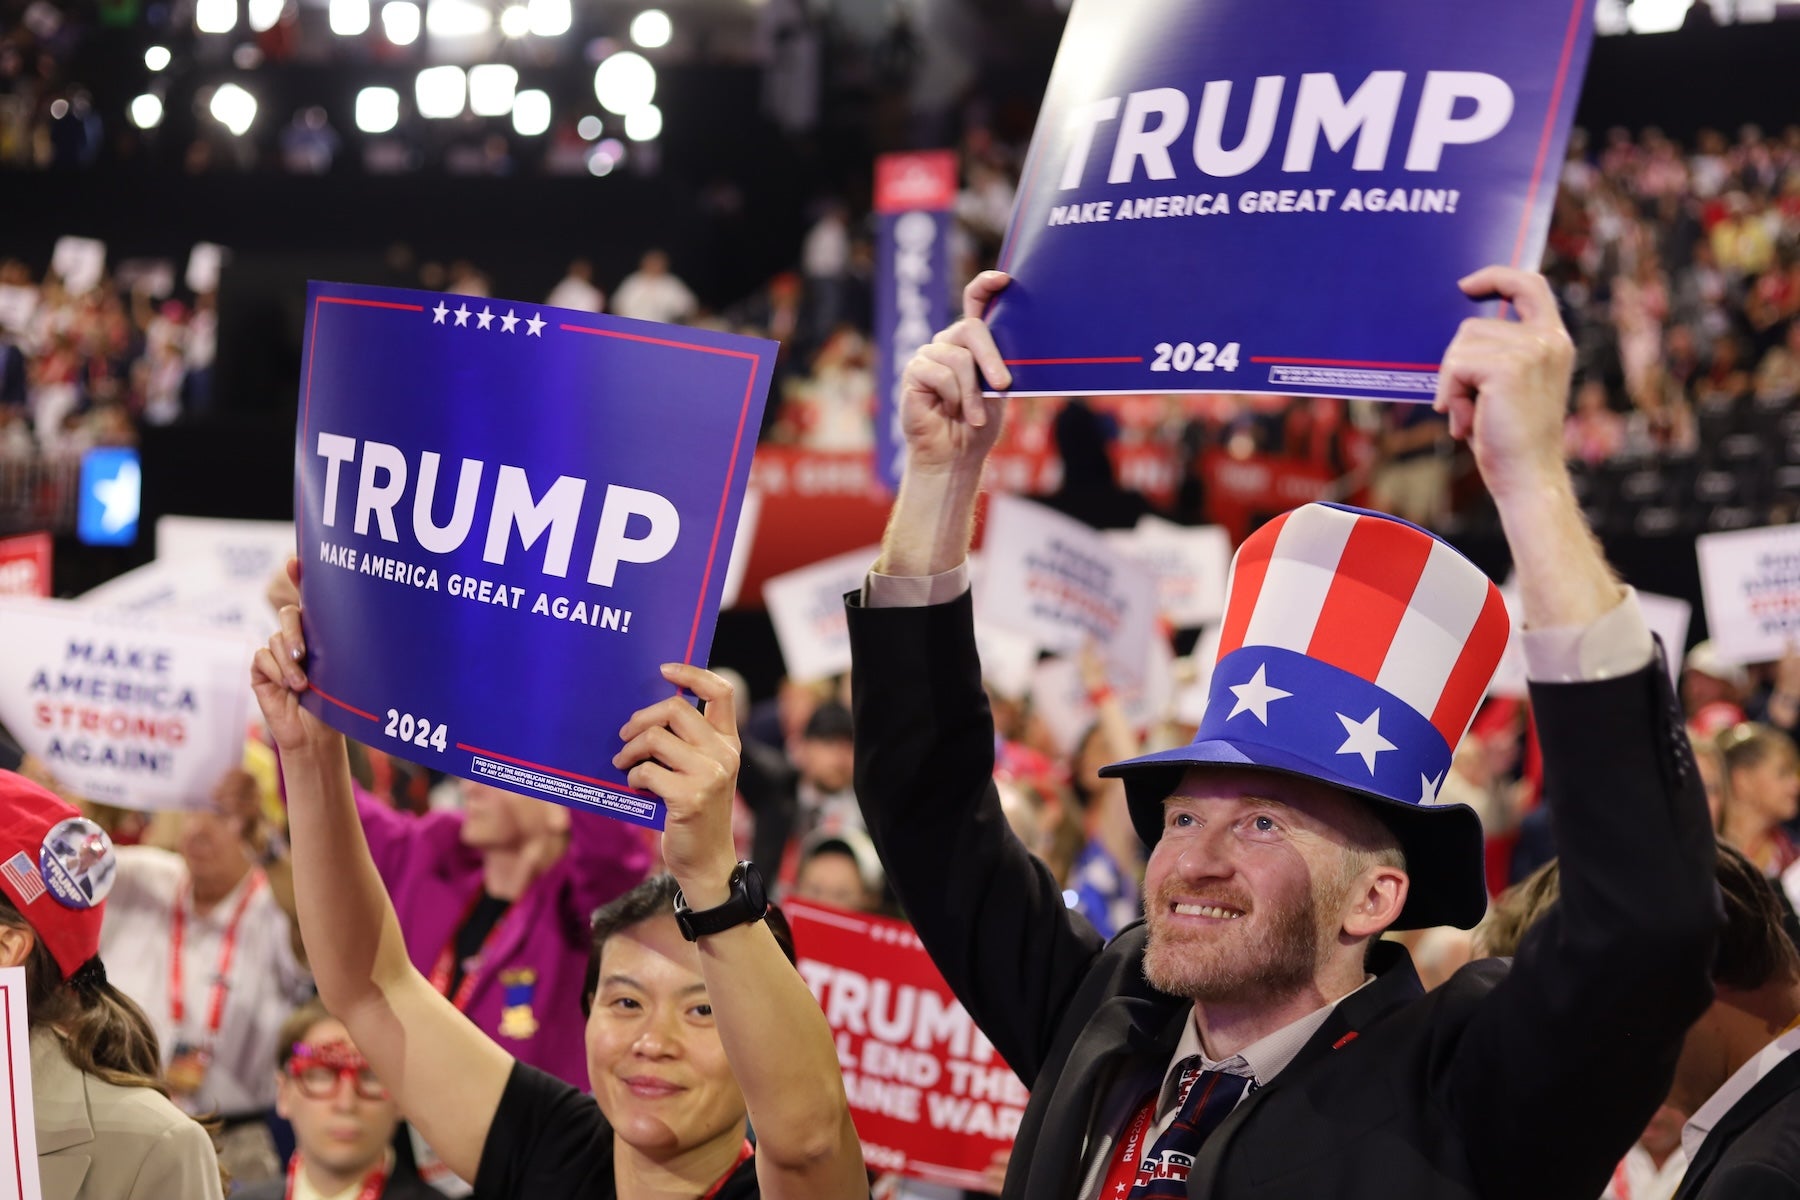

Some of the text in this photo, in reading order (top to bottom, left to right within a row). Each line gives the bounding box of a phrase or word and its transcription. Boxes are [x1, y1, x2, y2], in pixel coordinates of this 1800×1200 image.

[1059, 70, 1515, 191] TRUMP
[1047, 187, 1461, 227] MAKE AMERICA GREAT AGAIN!
[1149, 341, 1241, 372] 2024
[317, 431, 681, 588] TRUMP
[320, 541, 633, 634] MAKE AMERICA GREAT AGAIN!
[66, 638, 171, 672] MAKE
[30, 671, 197, 712] AMERICA
[35, 702, 188, 748] STRONG
[384, 708, 448, 753] 2024
[475, 759, 487, 768] PAID
[487, 762, 497, 770] FOR
[504, 767, 514, 775] THE
[514, 769, 546, 784] REPUBLICAN
[546, 777, 573, 790] NATIONAL
[573, 785, 606, 798] COMMITTEE.
[606, 794, 618, 802] NOT
[618, 797, 653, 811] AUTHORIZED
[487, 768, 498, 776] ANY
[497, 771, 526, 784] CANDIDATE
[533, 781, 568, 795] CANDIDATE'S
[568, 791, 601, 804] COMMITTEE.
[602, 799, 645, 814] WWW.GOP.COM
[46, 856, 82, 903] TRUMP
[860, 1038, 941, 1089] END
[1122, 1107, 1149, 1163] RNC2024
